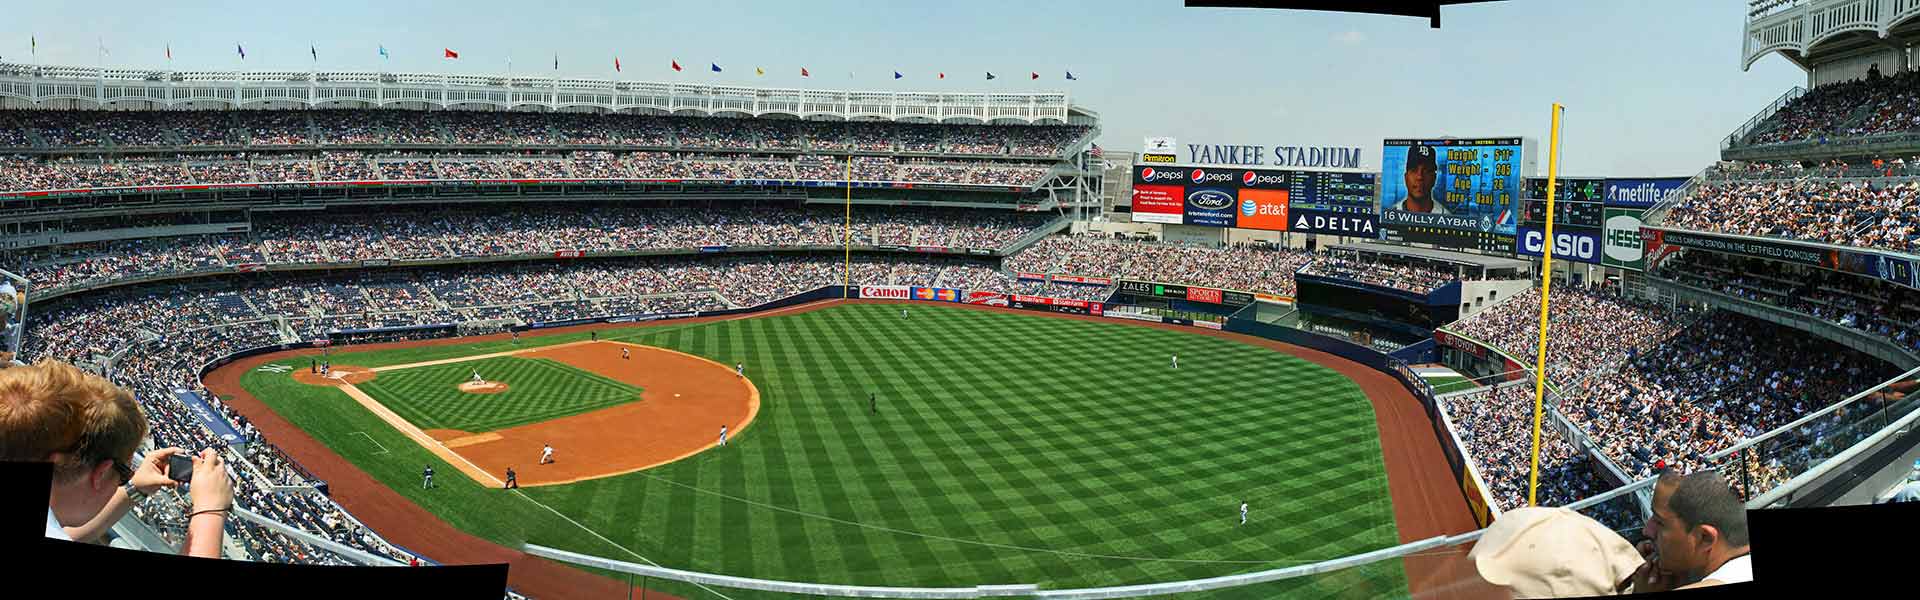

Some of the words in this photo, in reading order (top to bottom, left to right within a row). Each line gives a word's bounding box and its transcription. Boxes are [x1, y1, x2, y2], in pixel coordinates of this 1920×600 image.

[1187, 144, 1264, 166] YANKEE
[1274, 145, 1361, 169] STADIUM
[1448, 149, 1477, 161] Height
[1156, 170, 1183, 181] pepsi
[1448, 163, 1480, 176] Weight
[1206, 172, 1233, 182] pepsi
[1257, 174, 1285, 185] pepsi
[1454, 176, 1471, 190] Age
[1198, 194, 1223, 206] Ford
[1259, 202, 1286, 216] at&t
[1314, 215, 1374, 233] DELTA
[1384, 211, 1396, 221] 16
[1398, 213, 1434, 224] WILLY
[1437, 216, 1477, 228] AYBAR
[1525, 231, 1593, 259] CASIO
[1607, 229, 1641, 249] HESS
[1705, 240, 1726, 249] STATION
[1727, 242, 1734, 250] IN
[1734, 243, 1746, 253] THE
[862, 287, 908, 298] Canon
[1122, 282, 1150, 292] ZALES
[1189, 288, 1219, 298] SPORTS
[1455, 337, 1477, 354] TOYOTA
